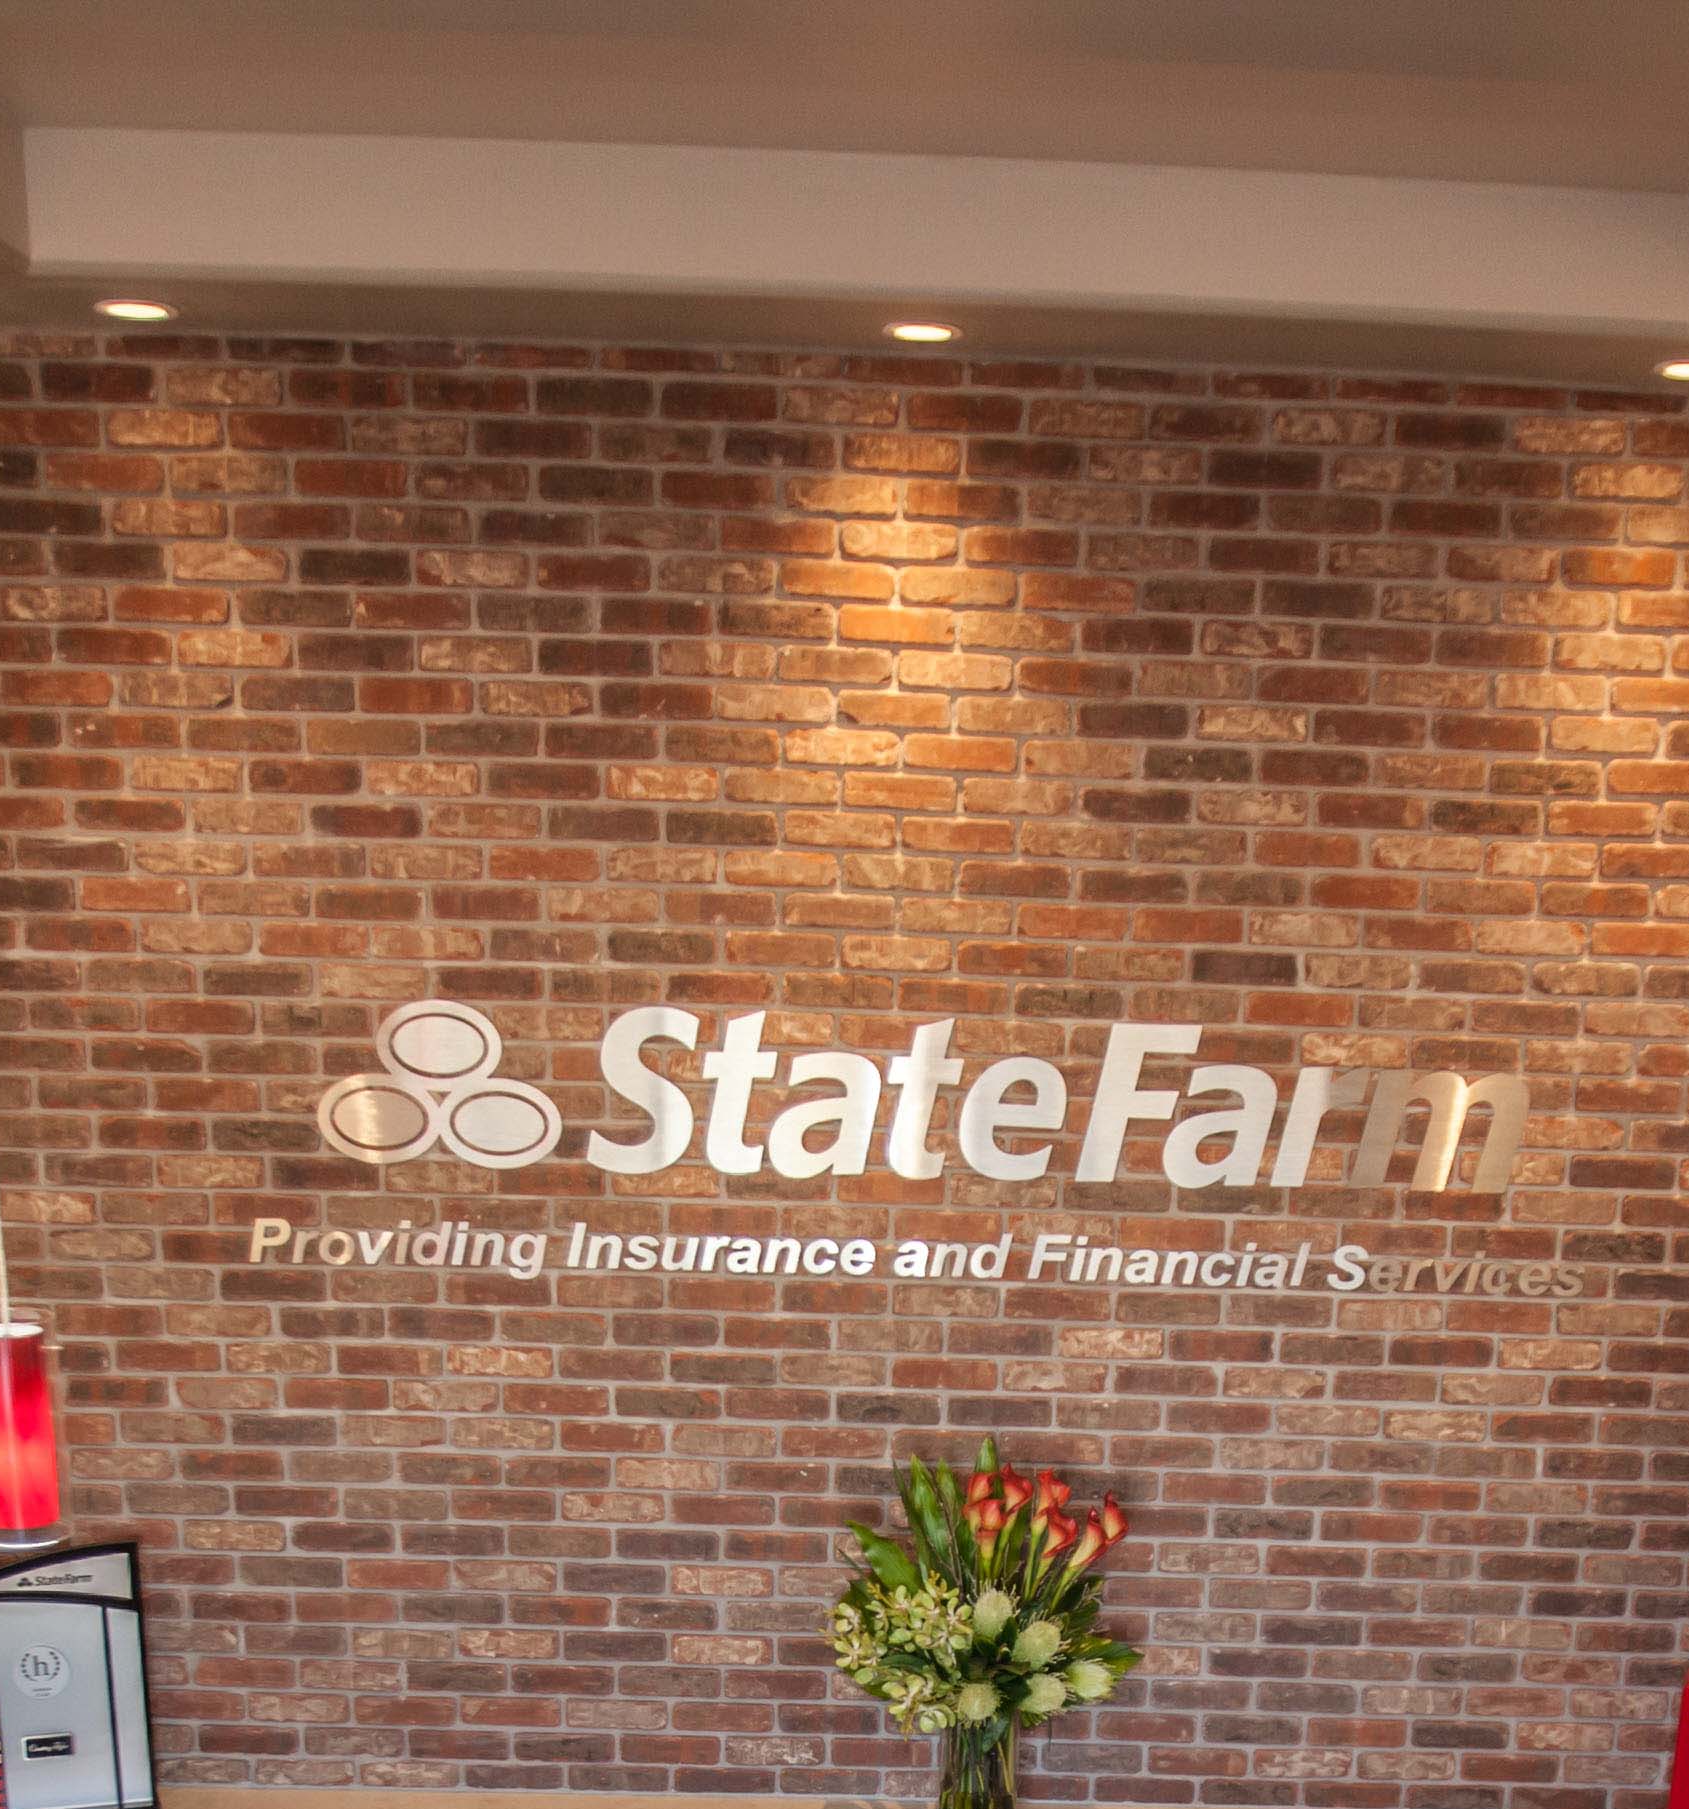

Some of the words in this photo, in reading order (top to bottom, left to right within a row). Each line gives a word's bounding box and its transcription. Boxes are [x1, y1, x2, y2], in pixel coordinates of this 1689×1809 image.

[248, 1217, 547, 1279] Providing
[566, 1222, 876, 1276] Insurance
[892, 1233, 1011, 1279] and
[1027, 1234, 1310, 1288] Financial
[1327, 1244, 1586, 1298] Services
